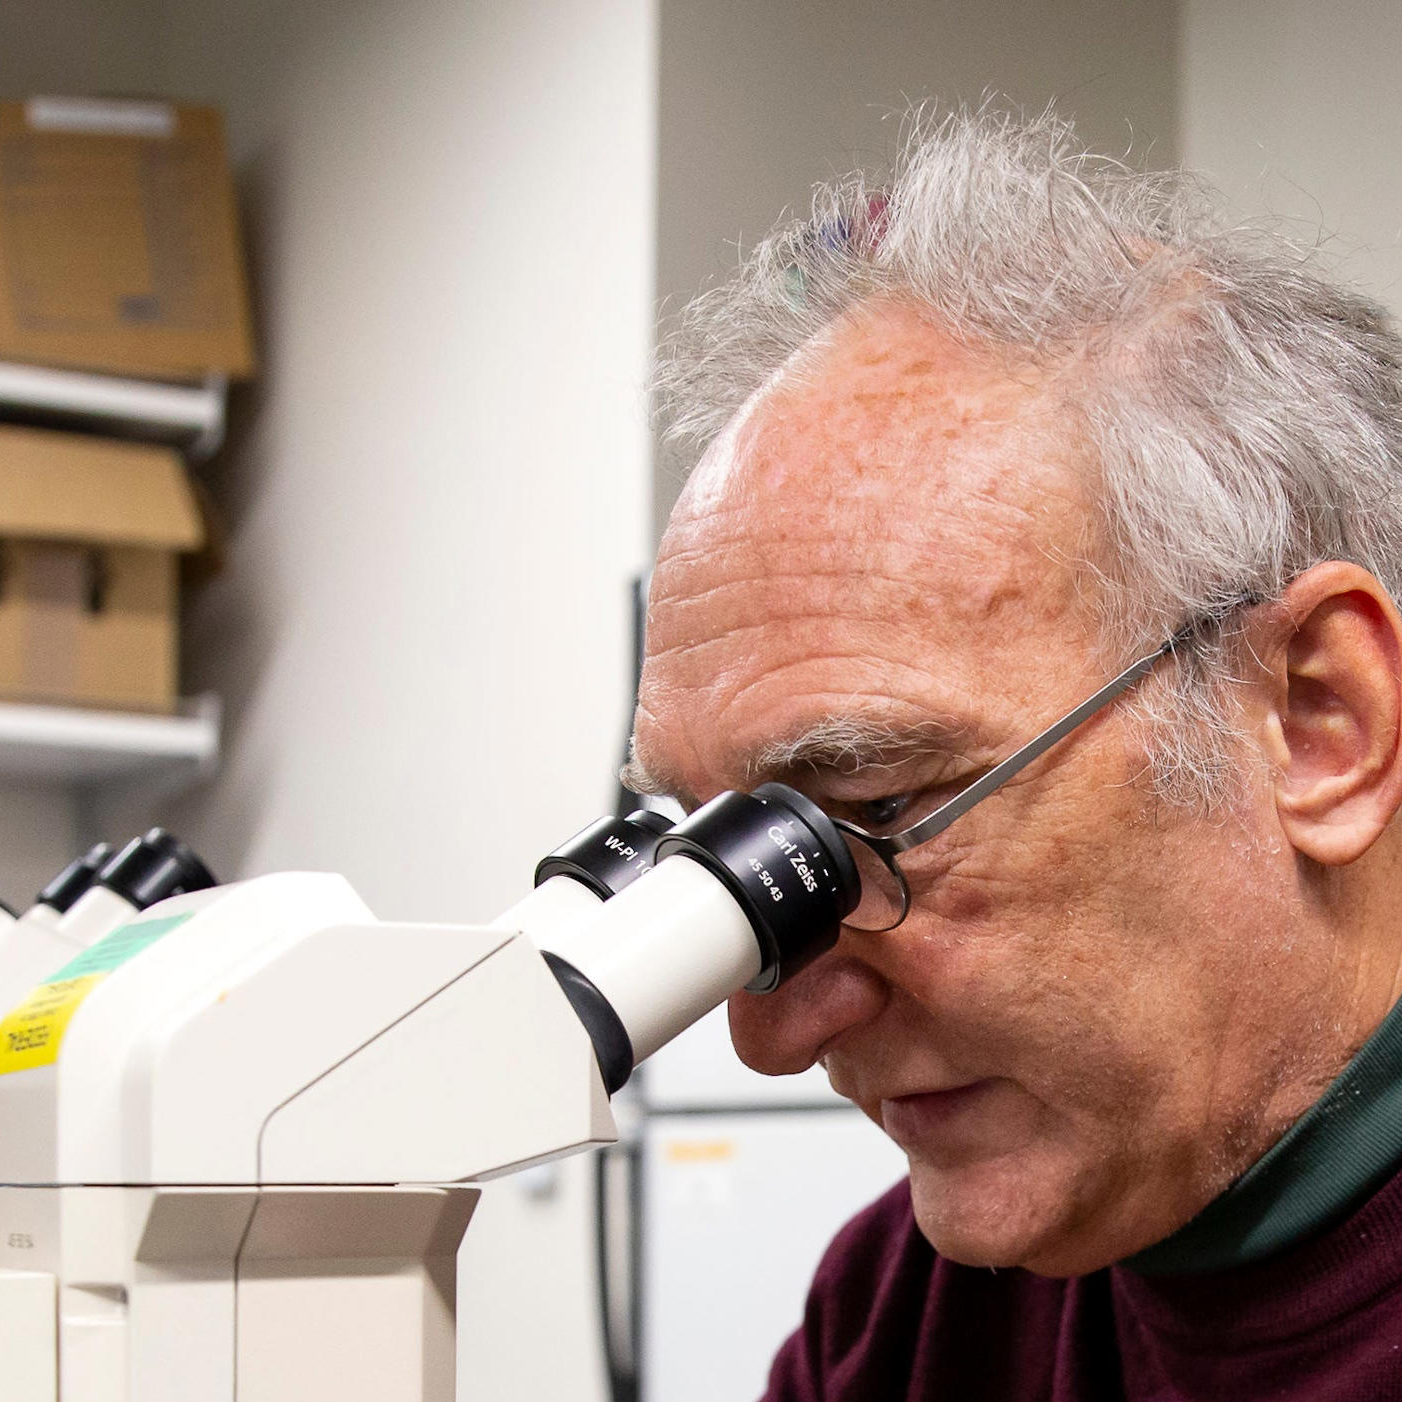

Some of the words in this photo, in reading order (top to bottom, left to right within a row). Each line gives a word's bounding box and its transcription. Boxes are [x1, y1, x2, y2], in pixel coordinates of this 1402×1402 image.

[747, 857, 763, 873] 45
[759, 870, 774, 887] 50
[769, 885, 784, 902] 43
[768, 826, 798, 856] Carl
[790, 853, 818, 893] Zeiss
